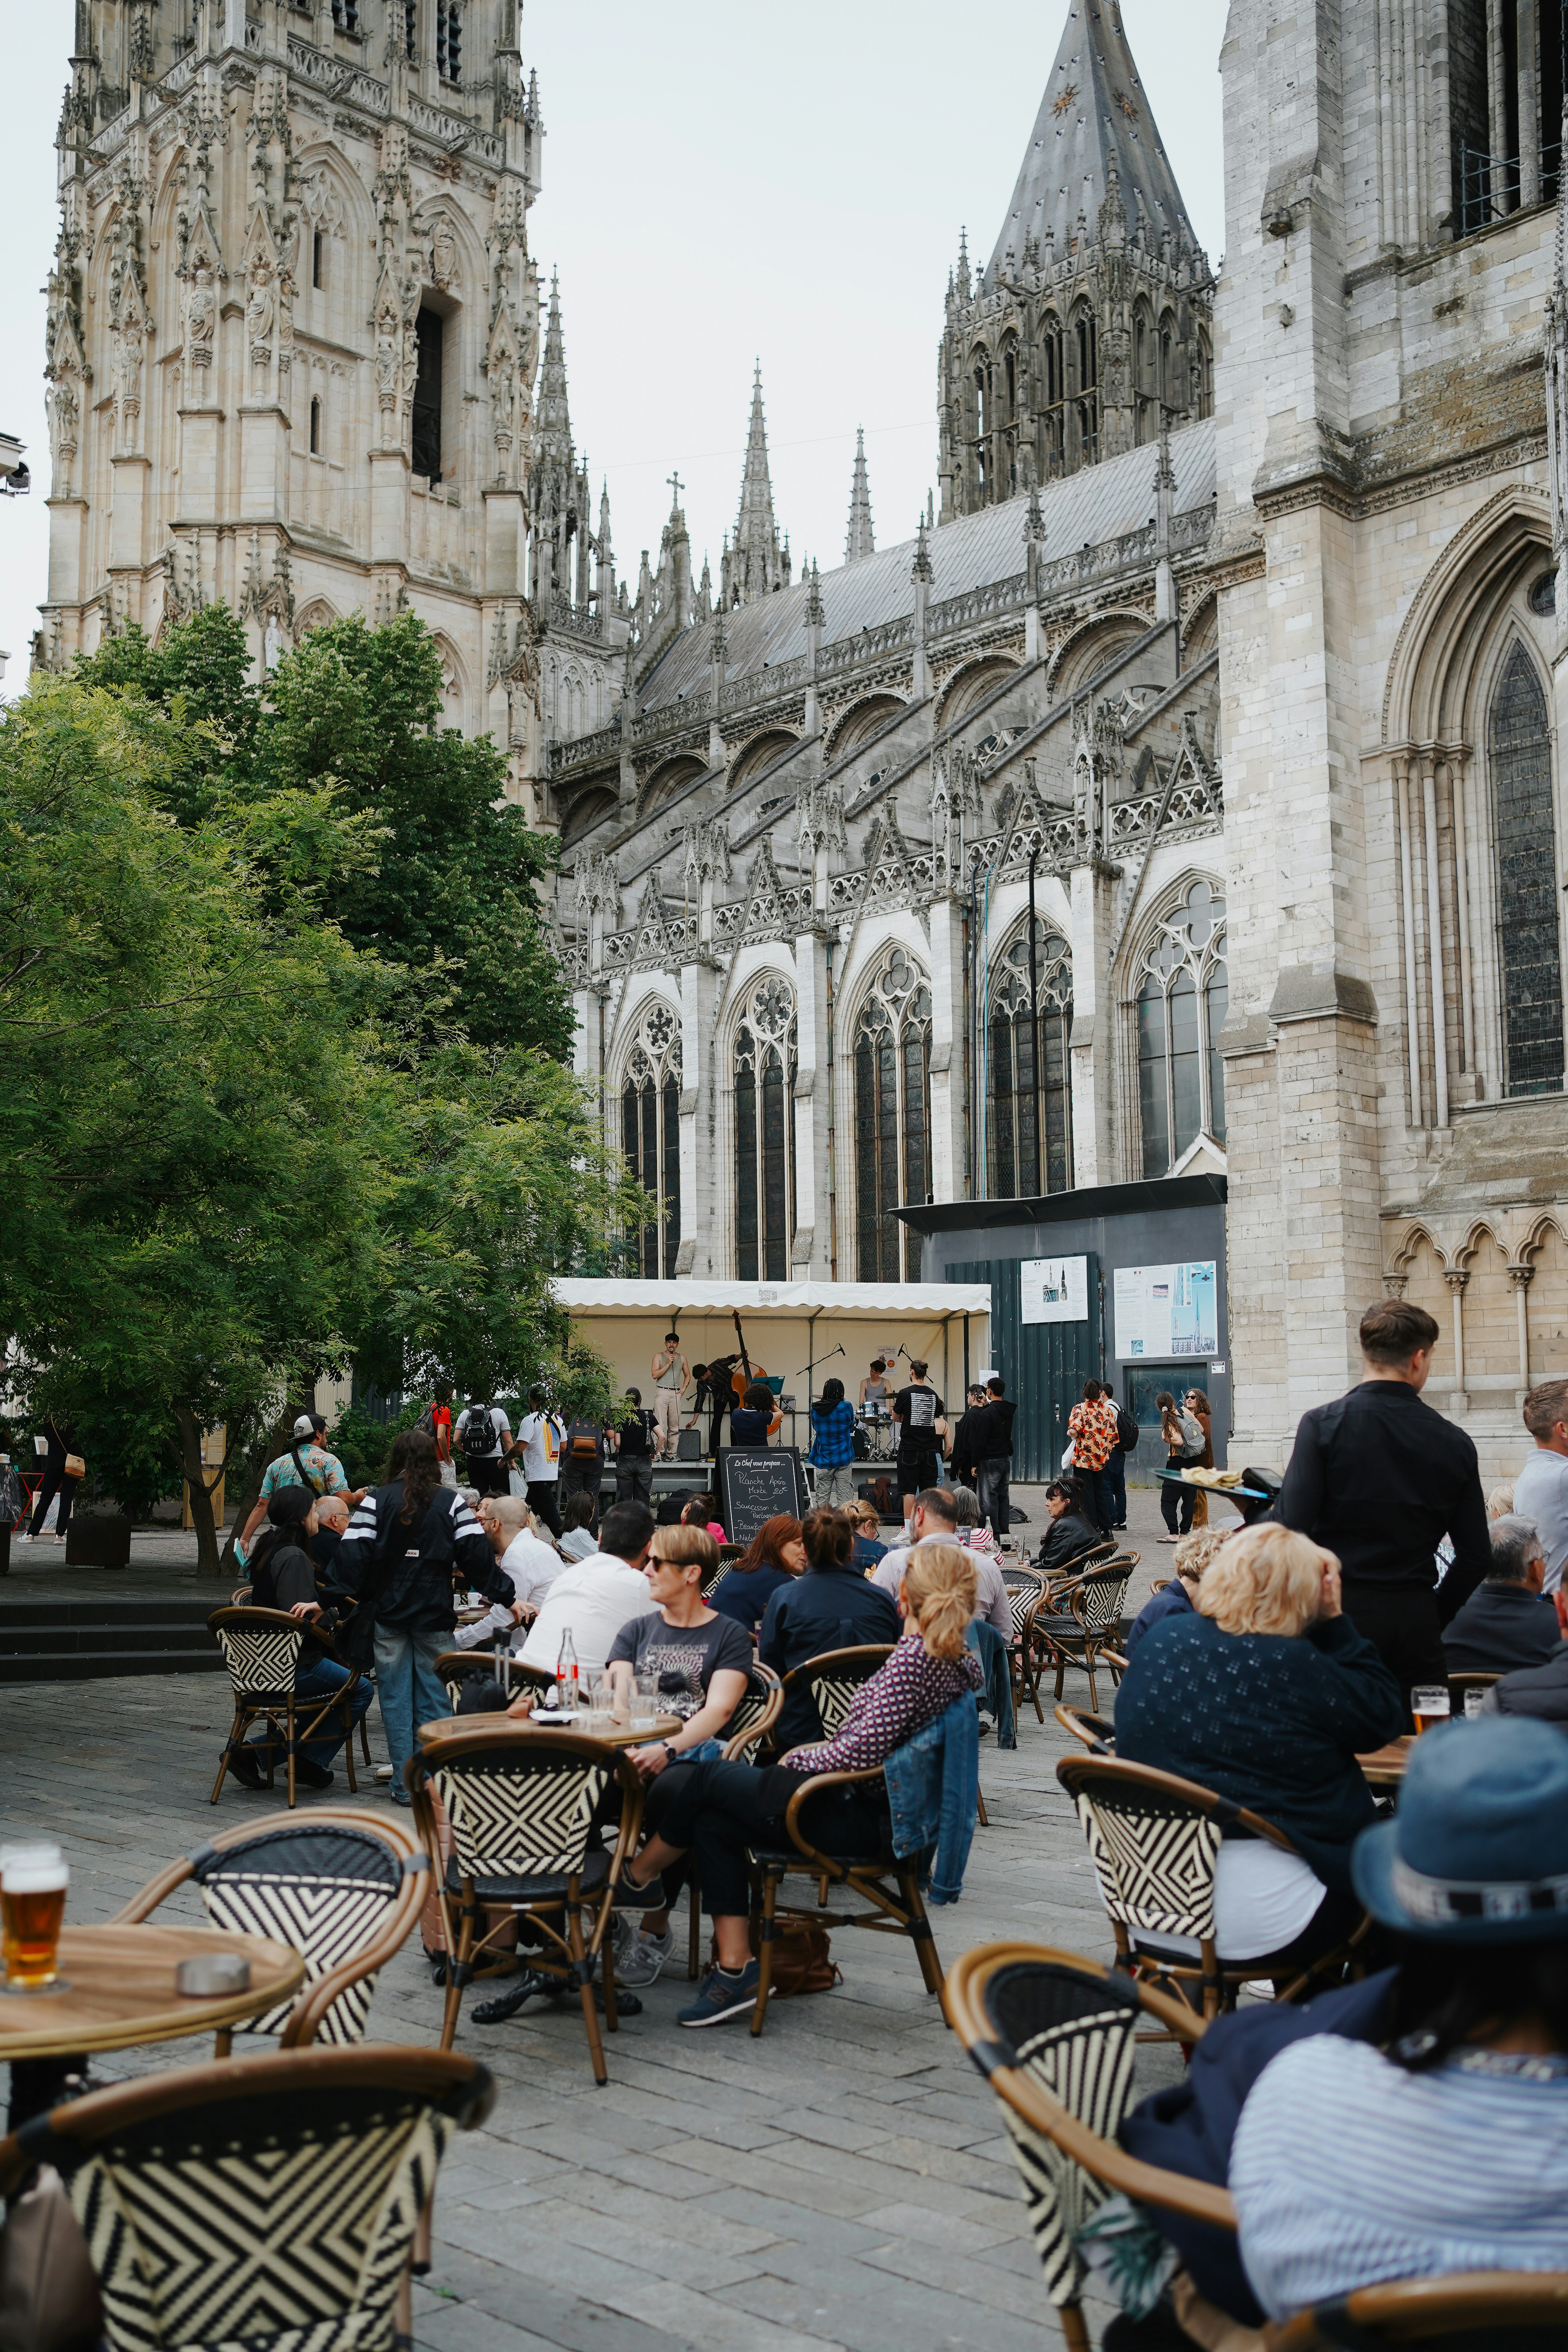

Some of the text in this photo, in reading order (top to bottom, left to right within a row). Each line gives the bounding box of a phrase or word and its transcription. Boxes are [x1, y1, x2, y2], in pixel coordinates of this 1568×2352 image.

[741, 1459, 753, 1468] Chef
[735, 1471, 786, 1487] Planche Apéro
[734, 1501, 769, 1510] Saucisson
[750, 1511, 776, 1521] Partager
